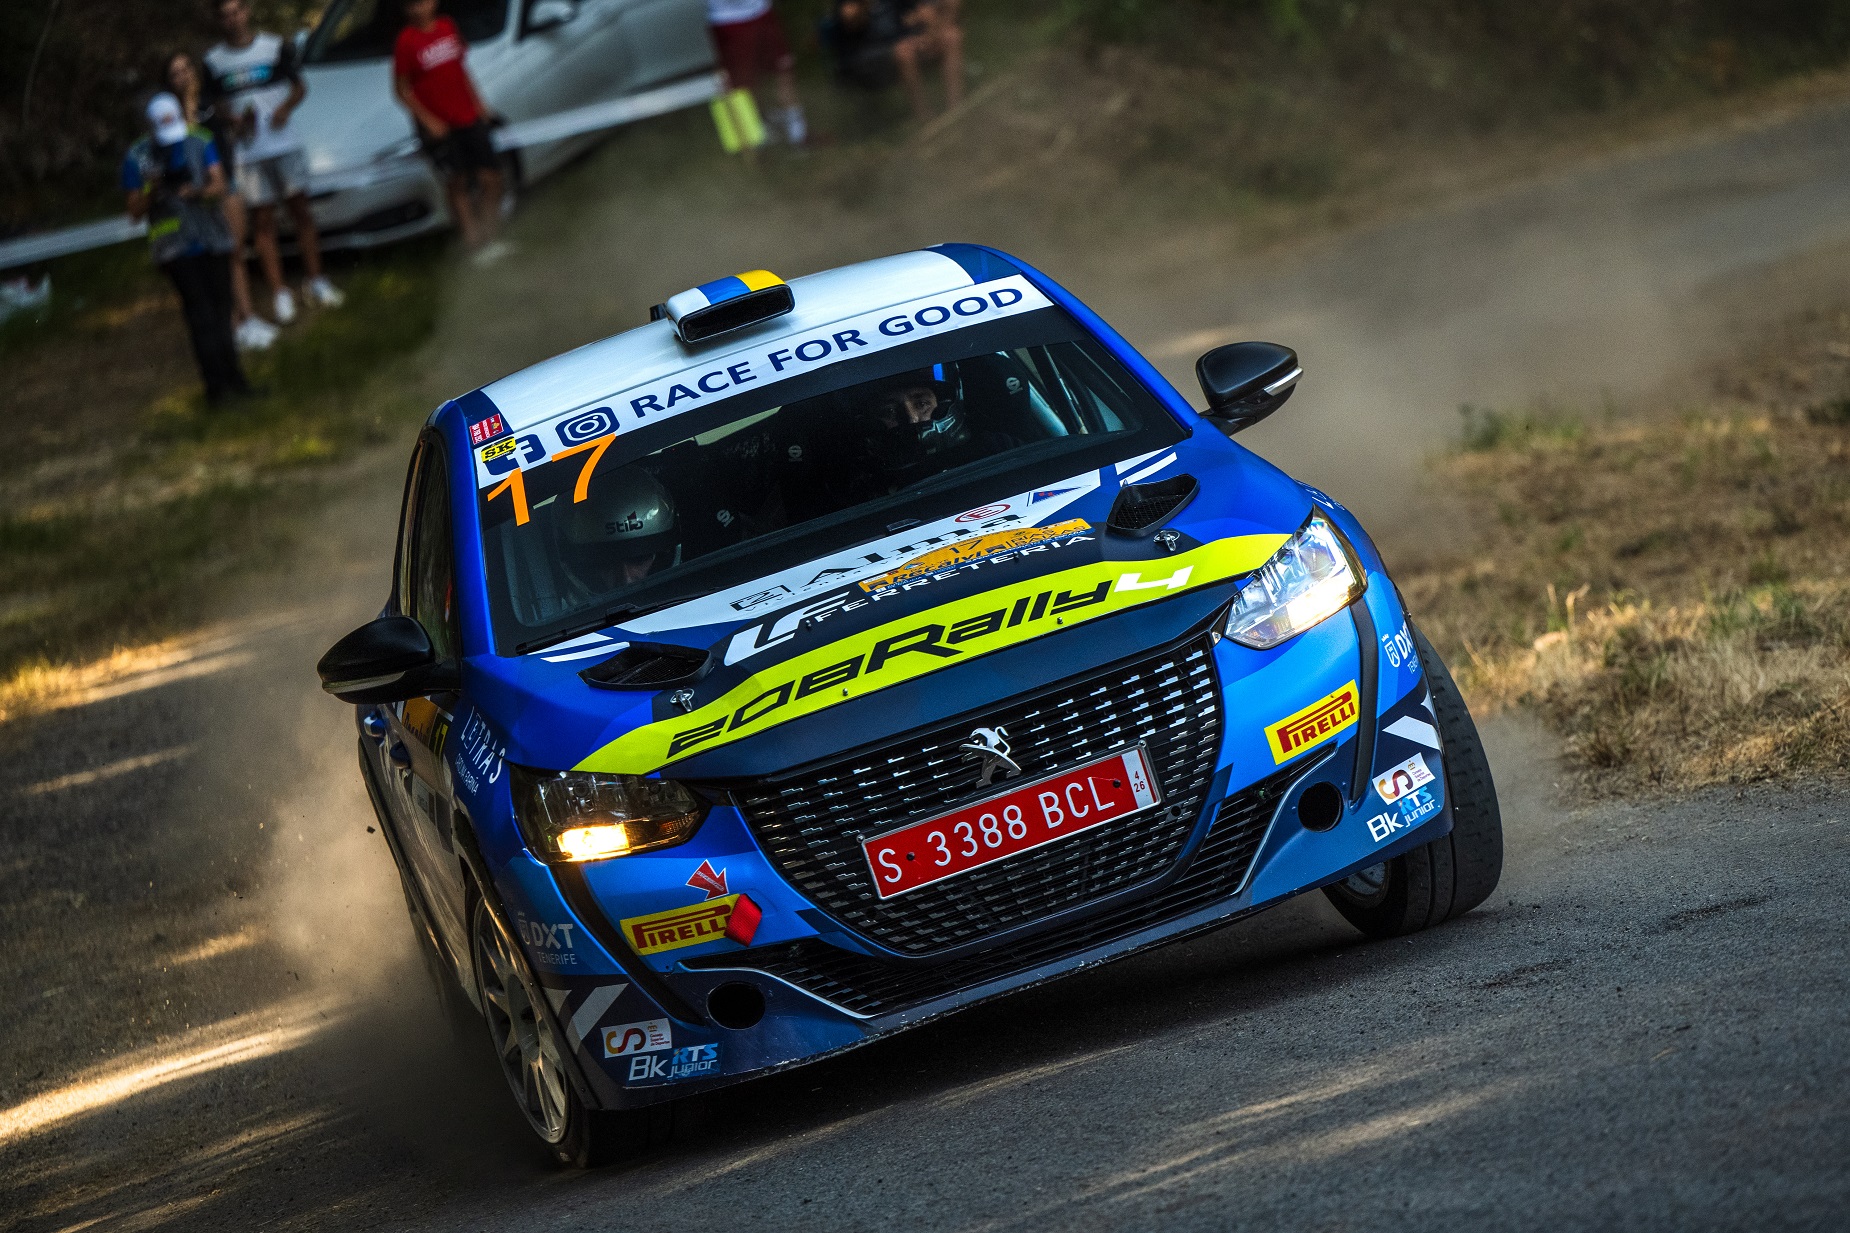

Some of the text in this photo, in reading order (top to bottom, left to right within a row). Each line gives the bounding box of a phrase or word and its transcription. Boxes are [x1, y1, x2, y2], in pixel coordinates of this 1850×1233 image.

[629, 287, 1023, 418] RACE FOR GOOD
[484, 440, 514, 459] SK
[487, 433, 617, 527] 17
[800, 514, 1027, 590] Alma
[949, 538, 984, 554] 17
[814, 536, 1095, 622] FERRETERIA
[893, 551, 982, 583] Recalvi
[1276, 691, 1356, 754] PIRELLI
[1133, 770, 1141, 781] 4
[1133, 780, 1146, 793] 26
[1399, 786, 1433, 815] RTS
[878, 777, 1115, 884] S 3388 BCL
[1366, 812, 1404, 842] Bk
[531, 923, 574, 950] DXT
[537, 953, 578, 965] TENERIFE
[628, 1055, 668, 1081] Bk
[672, 1043, 719, 1065] RTS
